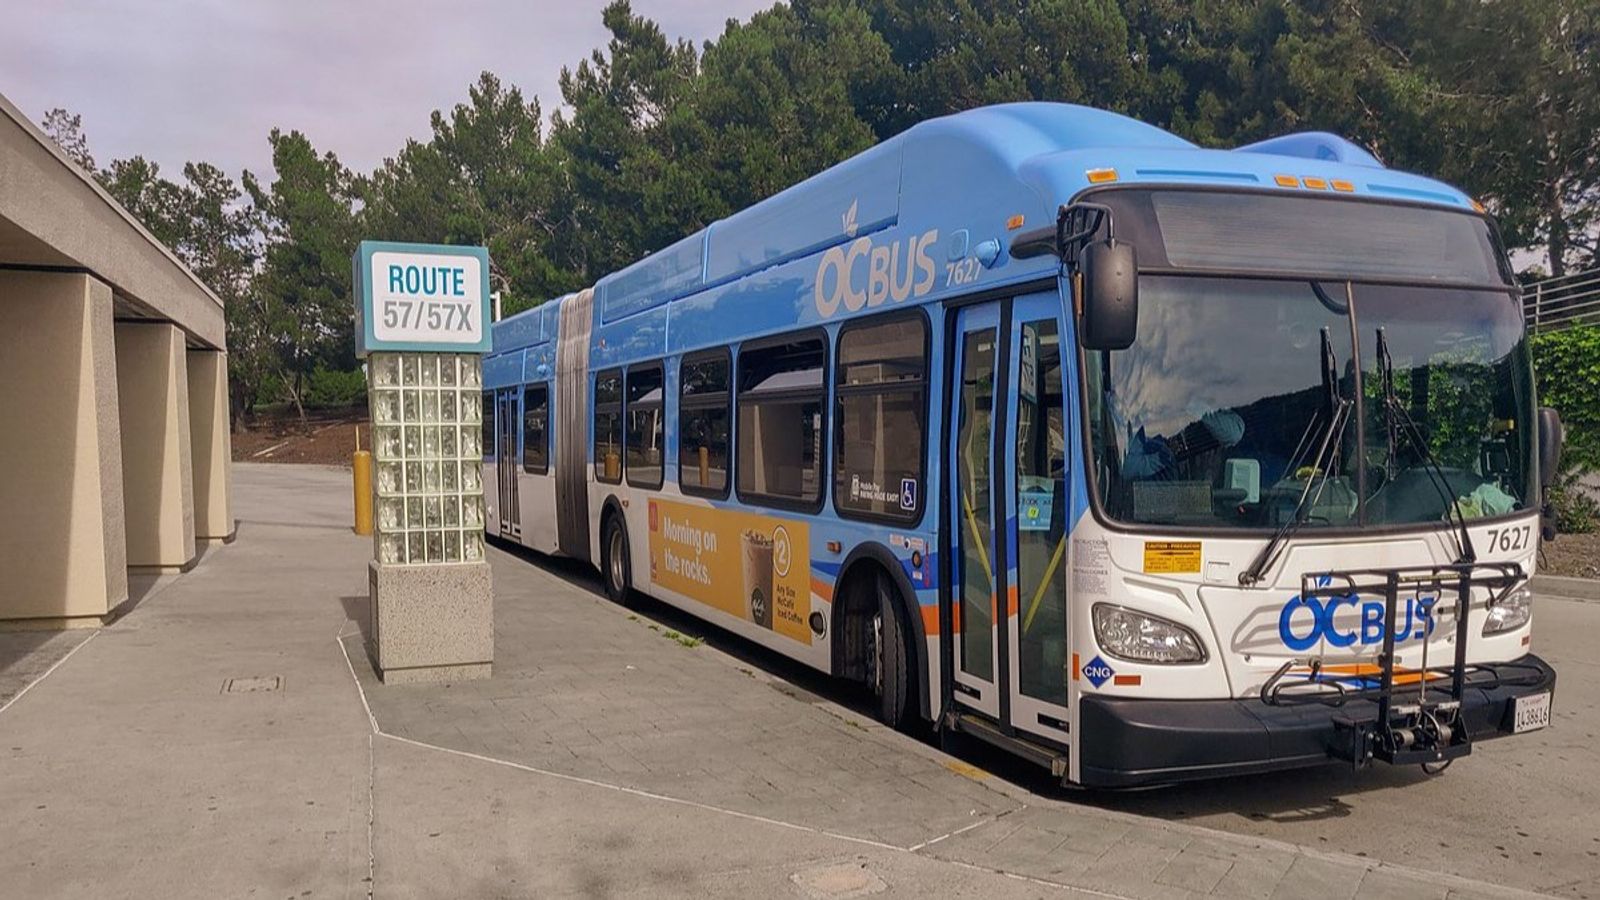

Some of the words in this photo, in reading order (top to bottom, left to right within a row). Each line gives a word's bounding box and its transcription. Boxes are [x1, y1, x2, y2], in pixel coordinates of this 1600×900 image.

[388, 264, 465, 296] ROUTE
[815, 228, 939, 319] OCBUS
[946, 256, 982, 287] 7627
[383, 300, 472, 331] 57/57X
[663, 515, 702, 555] Morning
[703, 530, 717, 552] on
[1487, 525, 1531, 554] 7627
[664, 548, 680, 574] the
[681, 556, 711, 585] rocks.
[776, 583, 785, 595] Any
[786, 587, 796, 598] Size
[777, 608, 787, 620] Iced
[788, 612, 803, 624] Coffee
[1278, 593, 1436, 652] OCBUS
[1084, 666, 1111, 678] CNG
